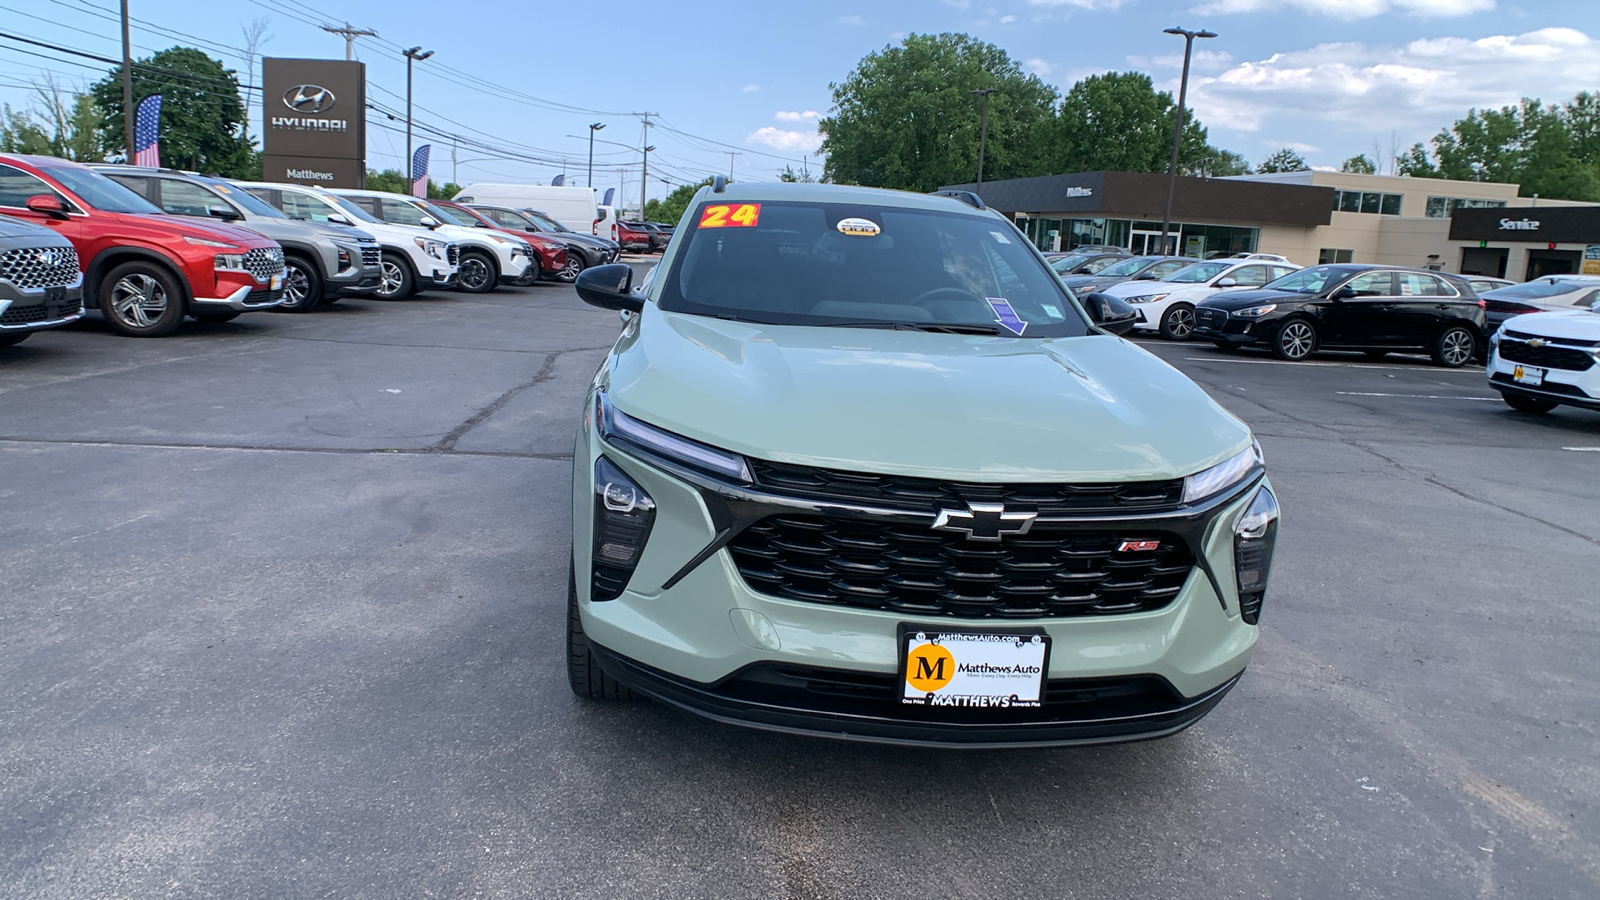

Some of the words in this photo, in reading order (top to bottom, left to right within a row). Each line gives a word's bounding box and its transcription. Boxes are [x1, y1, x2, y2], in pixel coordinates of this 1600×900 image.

[271, 117, 347, 131] HYUNDAI
[286, 168, 334, 180] Matthews
[701, 205, 757, 227] 24
[1499, 218, 1540, 230] Service
[1118, 541, 1160, 552] RS
[938, 633, 1021, 643] MatthewsAuto.com
[913, 656, 948, 680] M
[957, 662, 1012, 674] Matthews
[1012, 663, 1040, 674] Auto
[931, 694, 1010, 707] MATTHEWS
